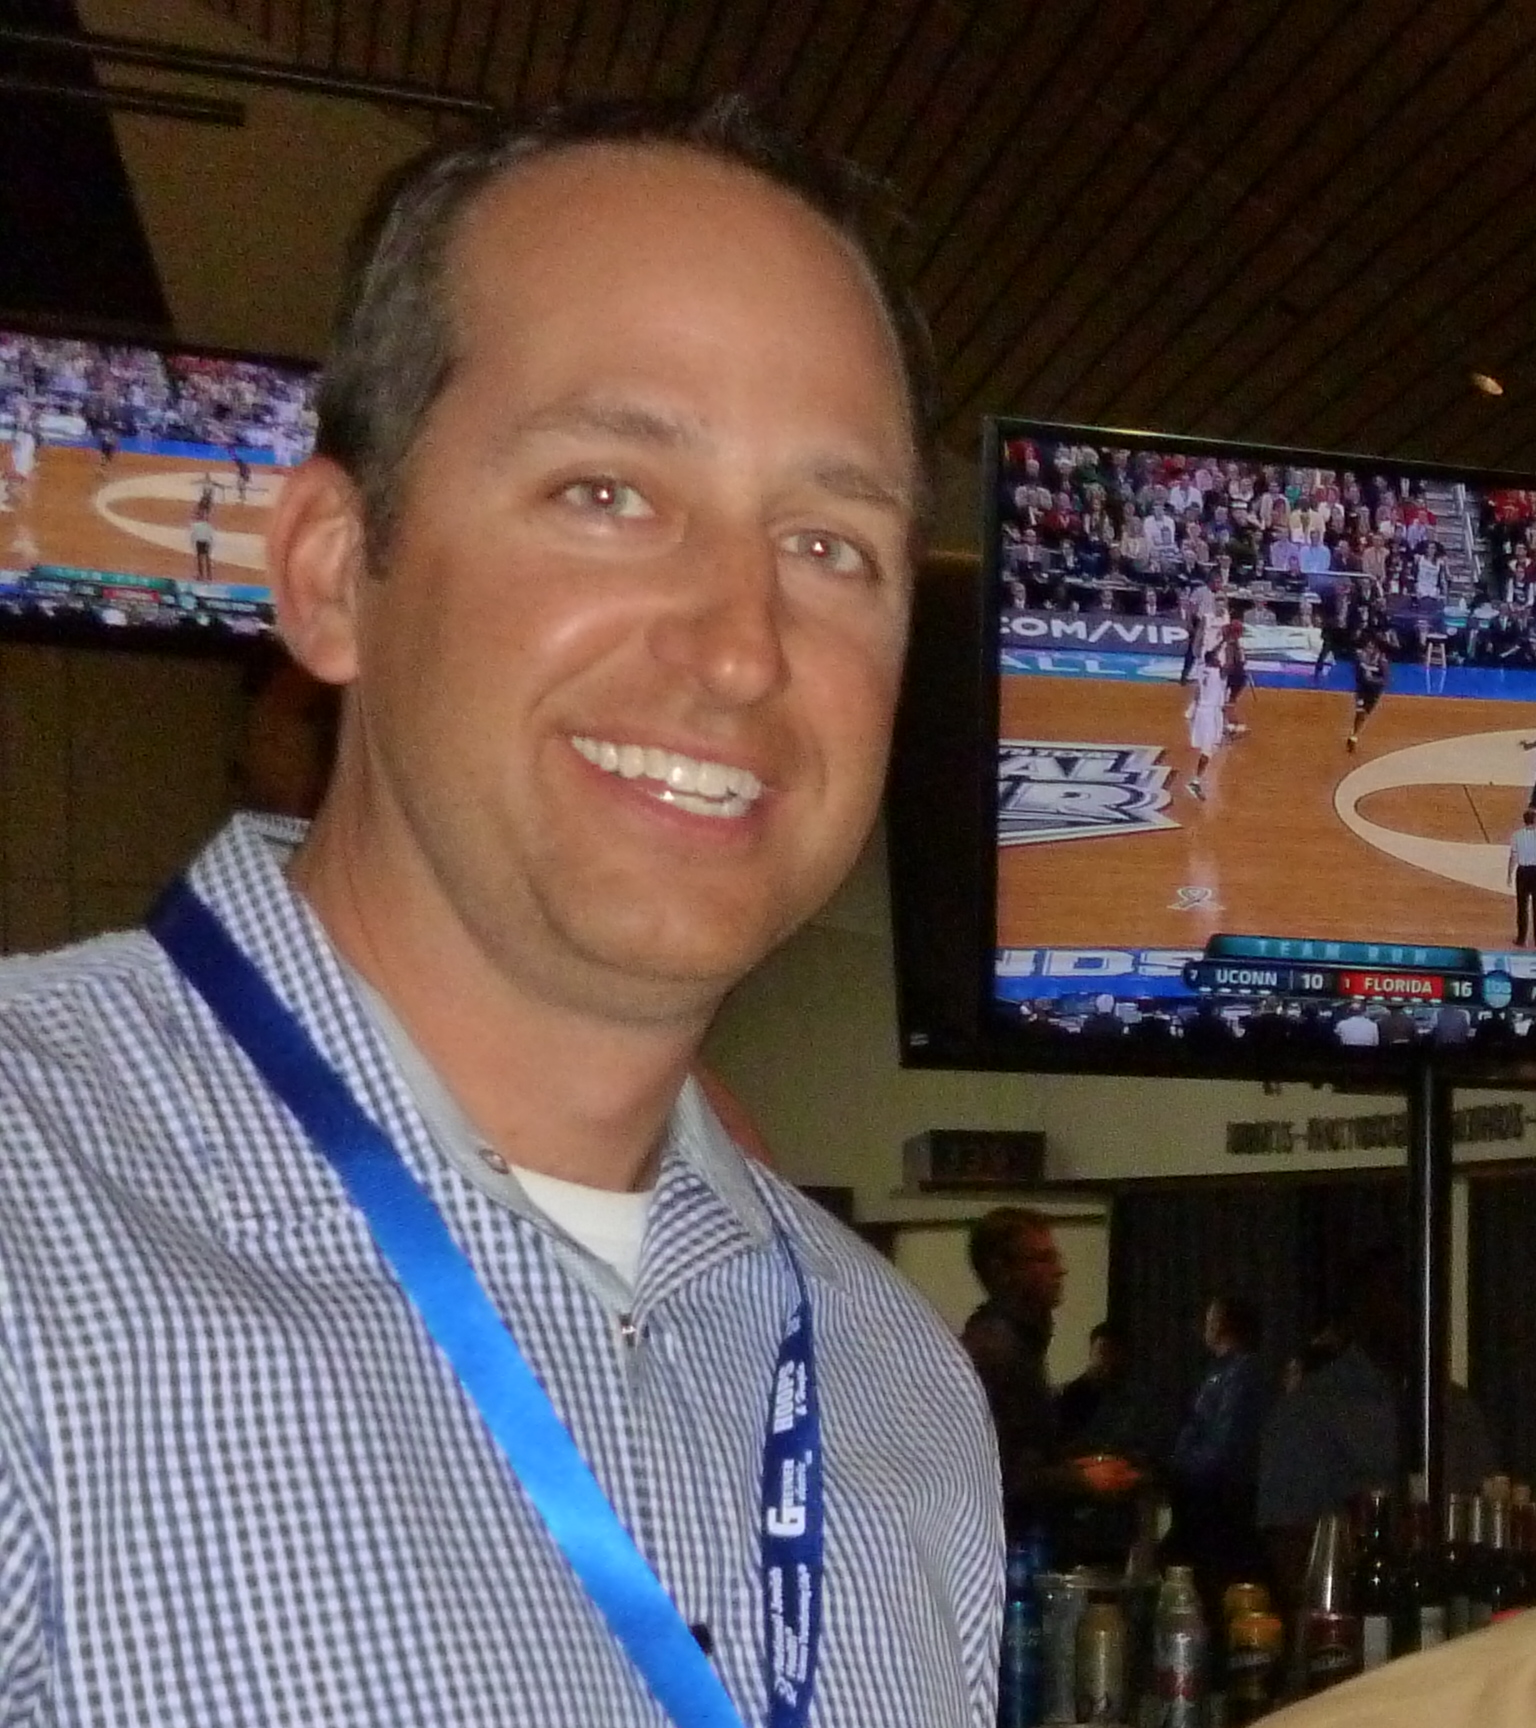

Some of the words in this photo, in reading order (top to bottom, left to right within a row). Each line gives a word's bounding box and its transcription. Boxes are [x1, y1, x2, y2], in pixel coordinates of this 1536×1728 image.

[1215, 968, 1279, 987] UCONN
[1301, 973, 1325, 990] 10
[1364, 976, 1433, 994] FLORIDA
[1452, 981, 1473, 998] 16
